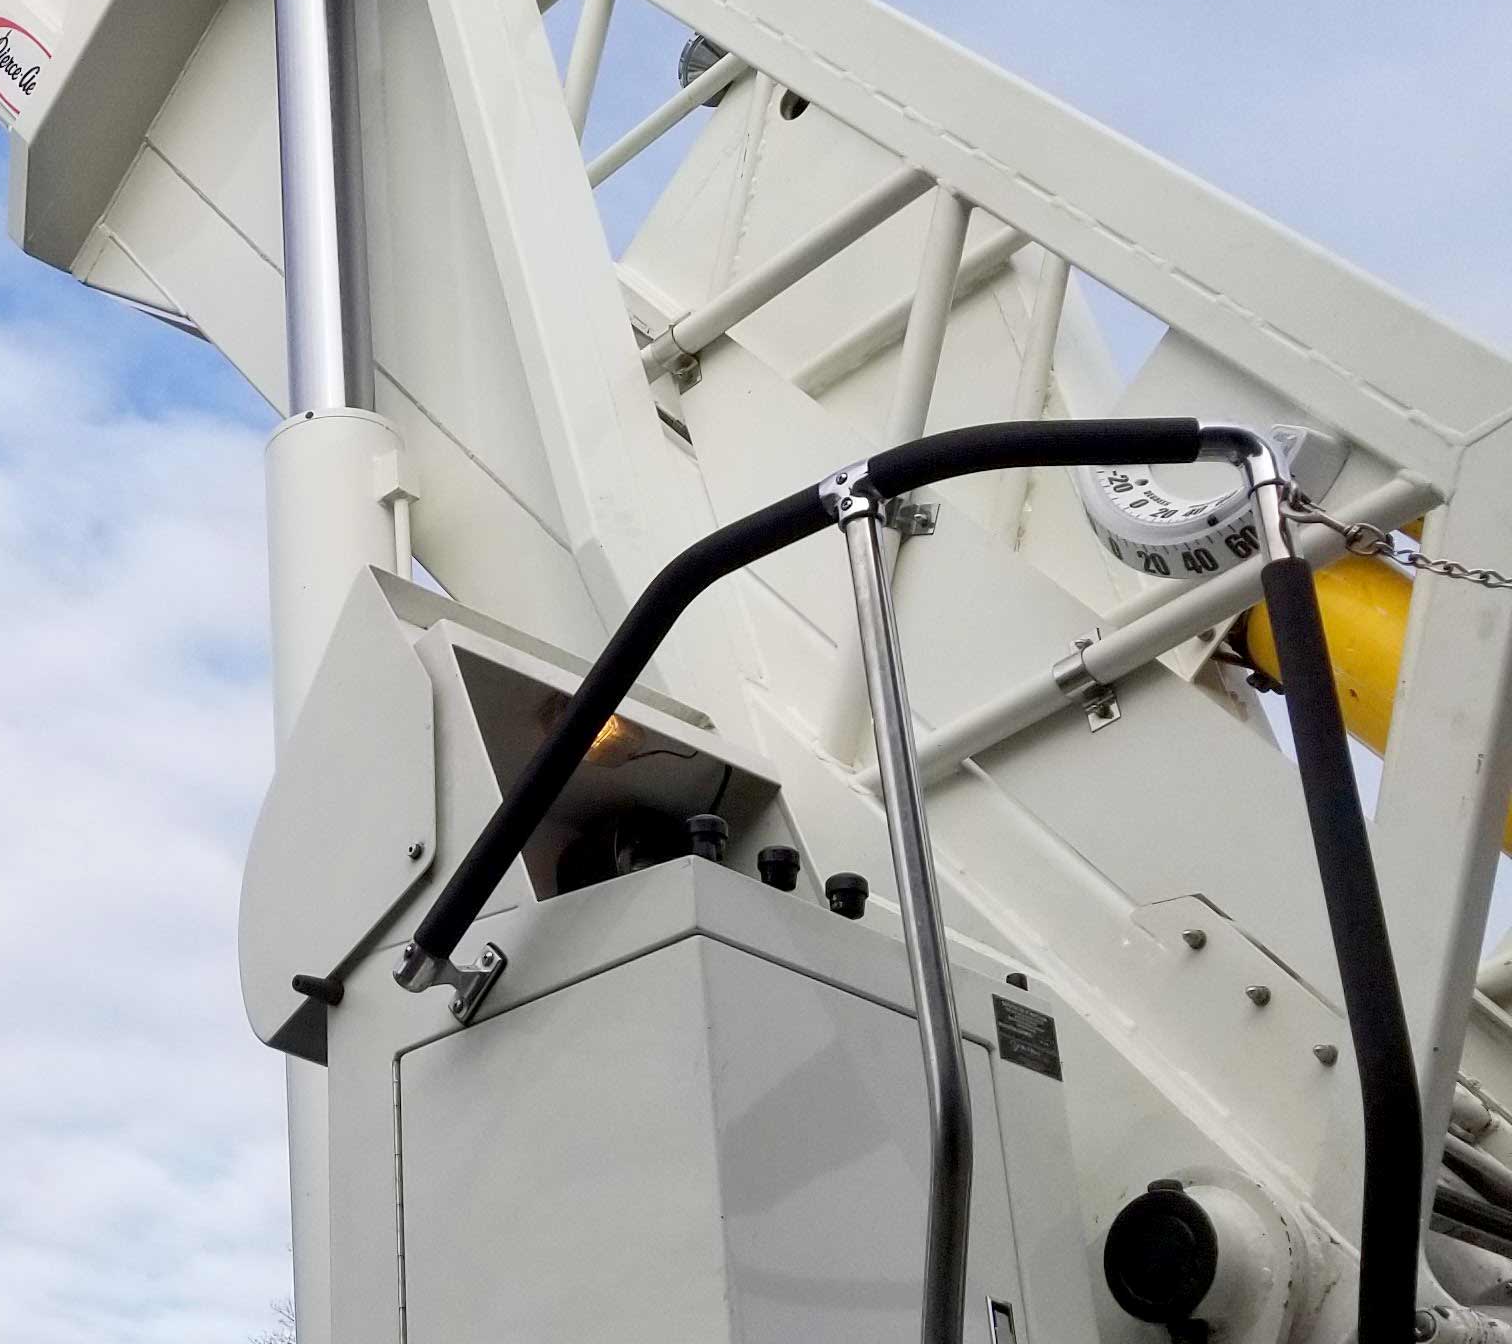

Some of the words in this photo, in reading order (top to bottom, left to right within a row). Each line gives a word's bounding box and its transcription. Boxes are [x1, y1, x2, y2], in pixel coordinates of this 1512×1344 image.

[1129, 498, 1150, 509] 0
[1149, 507, 1179, 519] 20
[1136, 550, 1171, 576] 20
[1181, 547, 1220, 574] 40
[1224, 525, 1261, 559] 60
